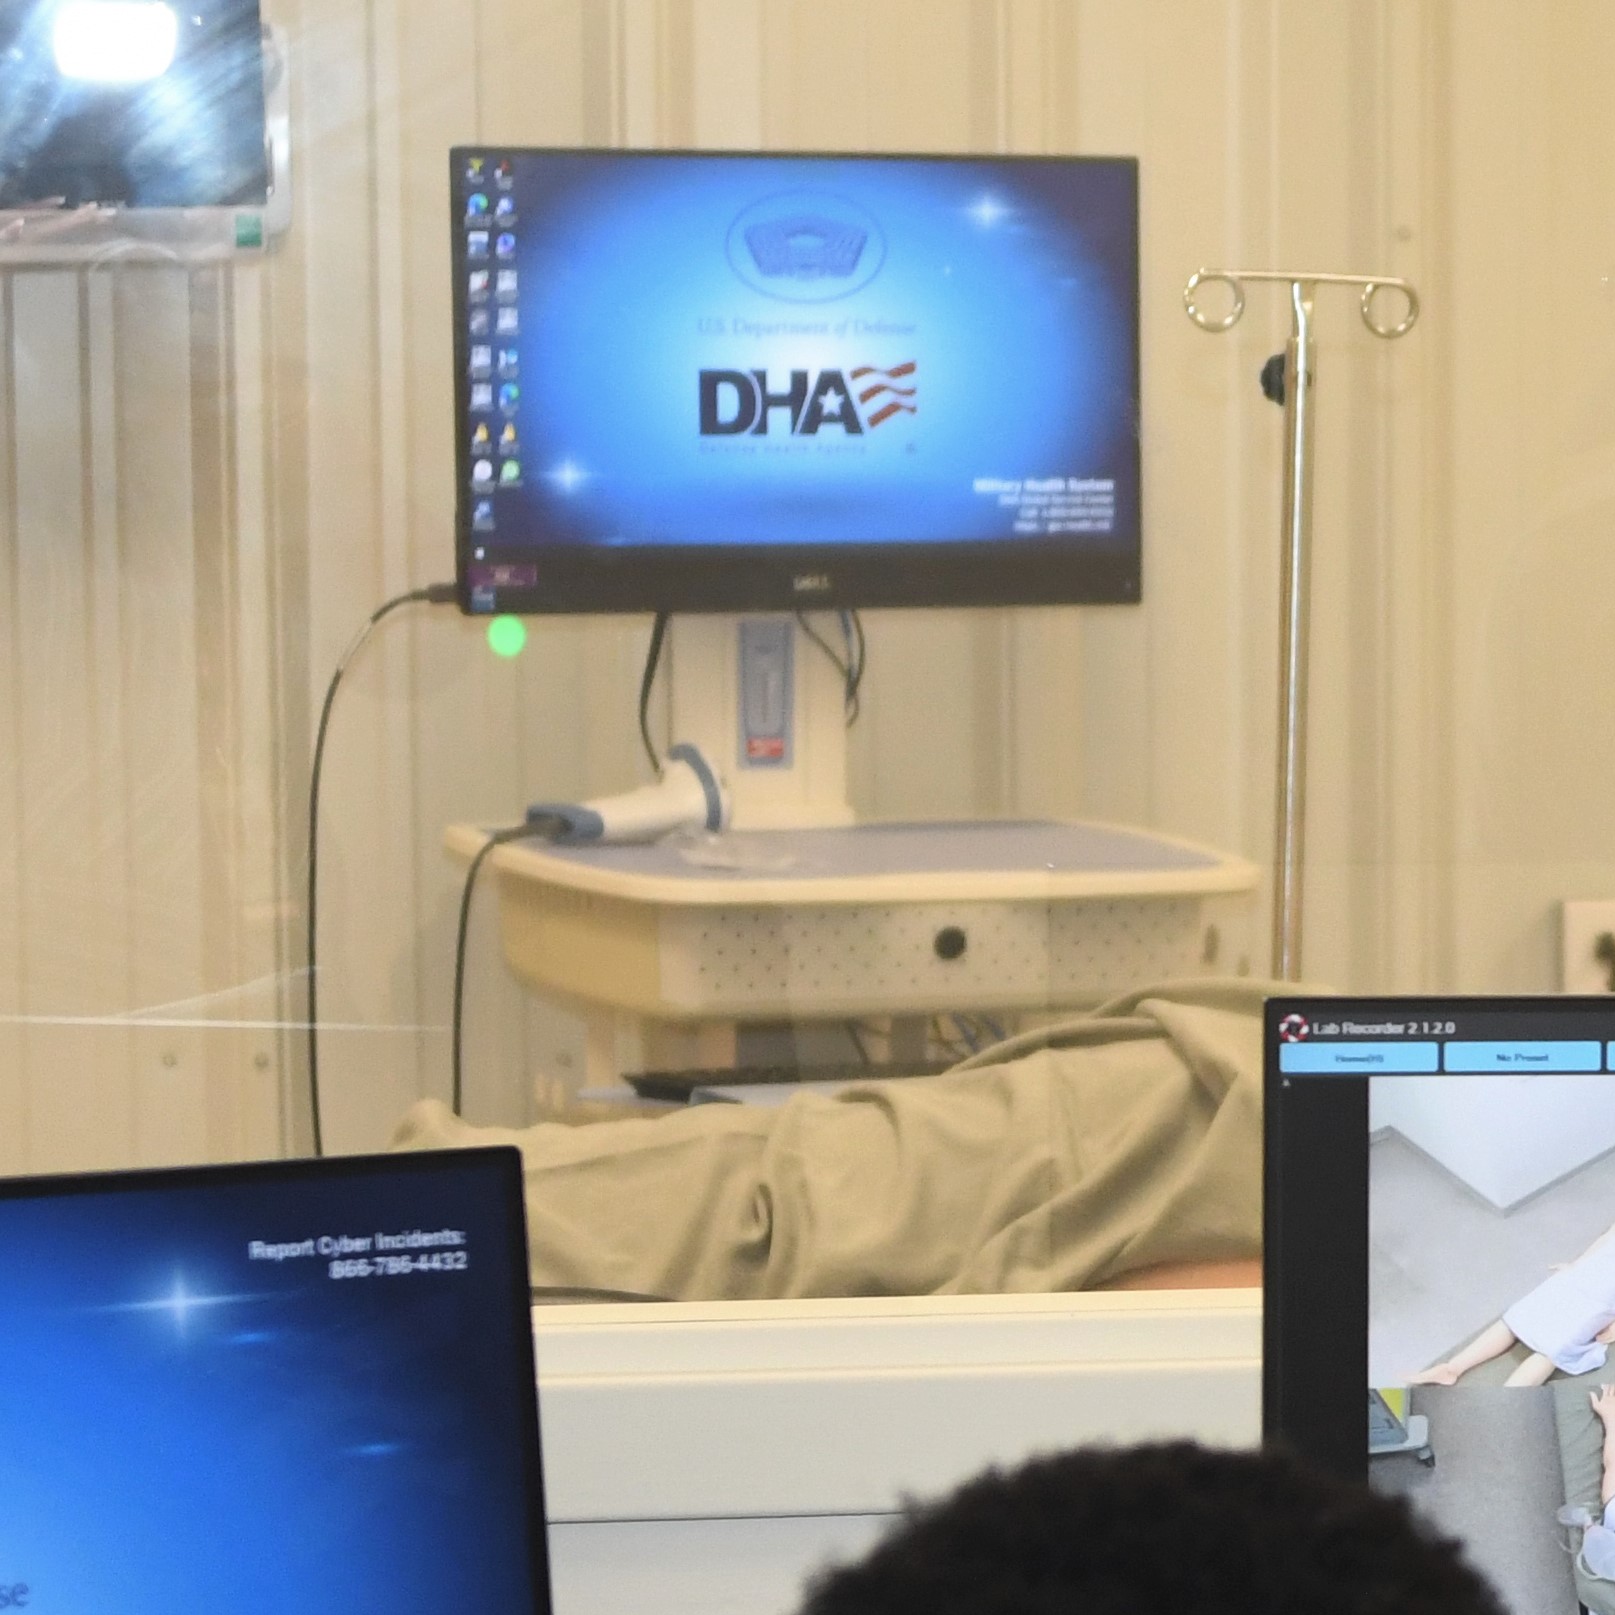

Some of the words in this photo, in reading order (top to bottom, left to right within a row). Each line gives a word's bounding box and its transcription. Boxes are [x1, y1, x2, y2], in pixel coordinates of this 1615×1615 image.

[699, 368, 864, 436] DHA
[1312, 1021, 1340, 1035] Lab
[1342, 1021, 1405, 1035] Recorder
[248, 1238, 315, 1262] Report
[316, 1234, 372, 1257] Cyber
[374, 1228, 467, 1250] Incidents:
